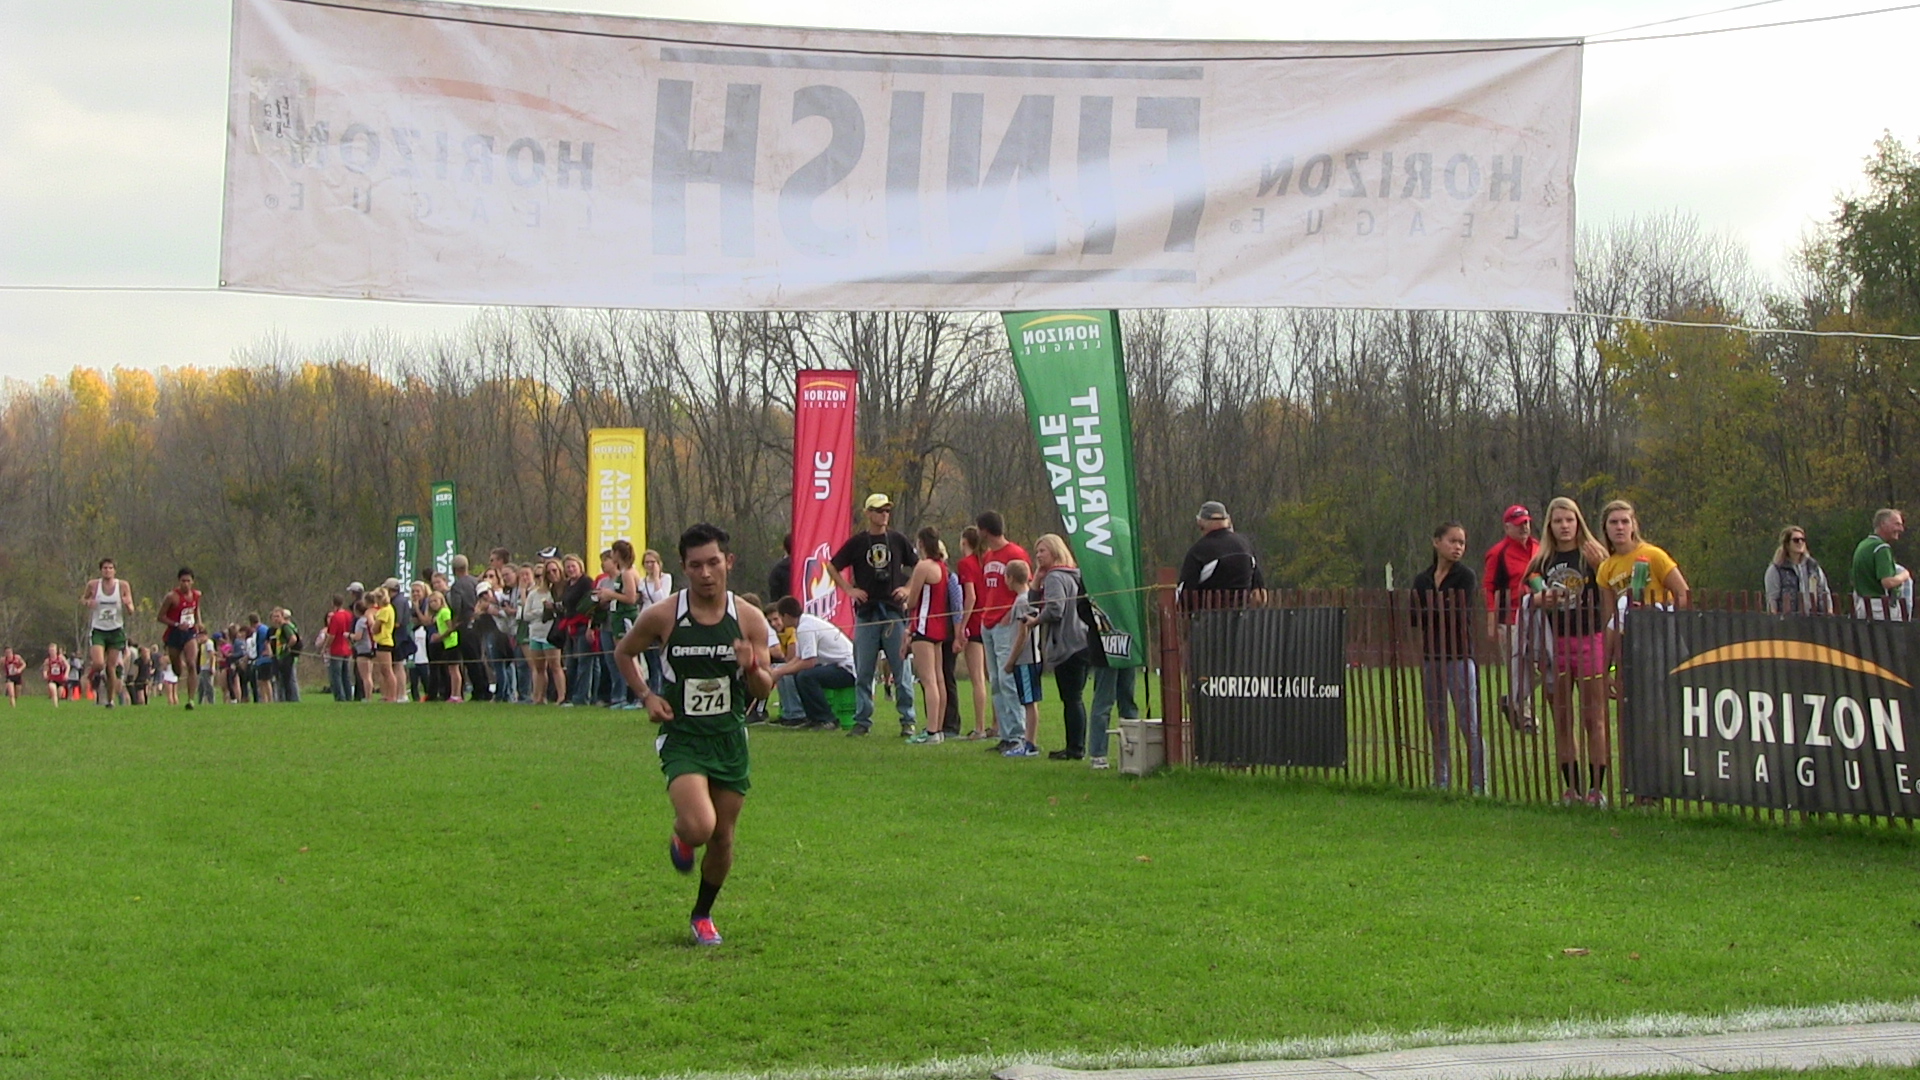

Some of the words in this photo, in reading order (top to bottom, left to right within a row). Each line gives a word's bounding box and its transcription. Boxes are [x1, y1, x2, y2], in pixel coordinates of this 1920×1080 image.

[803, 390, 847, 401] HORIZON
[814, 450, 834, 501] UIC
[600, 468, 615, 553] THERN
[616, 469, 632, 542] TUCKY
[671, 645, 716, 658] GREEN
[716, 644, 735, 655] BA
[692, 693, 725, 712] 274
[1683, 686, 1906, 752] HORIZON
[1683, 747, 1912, 794] LEAGUE
